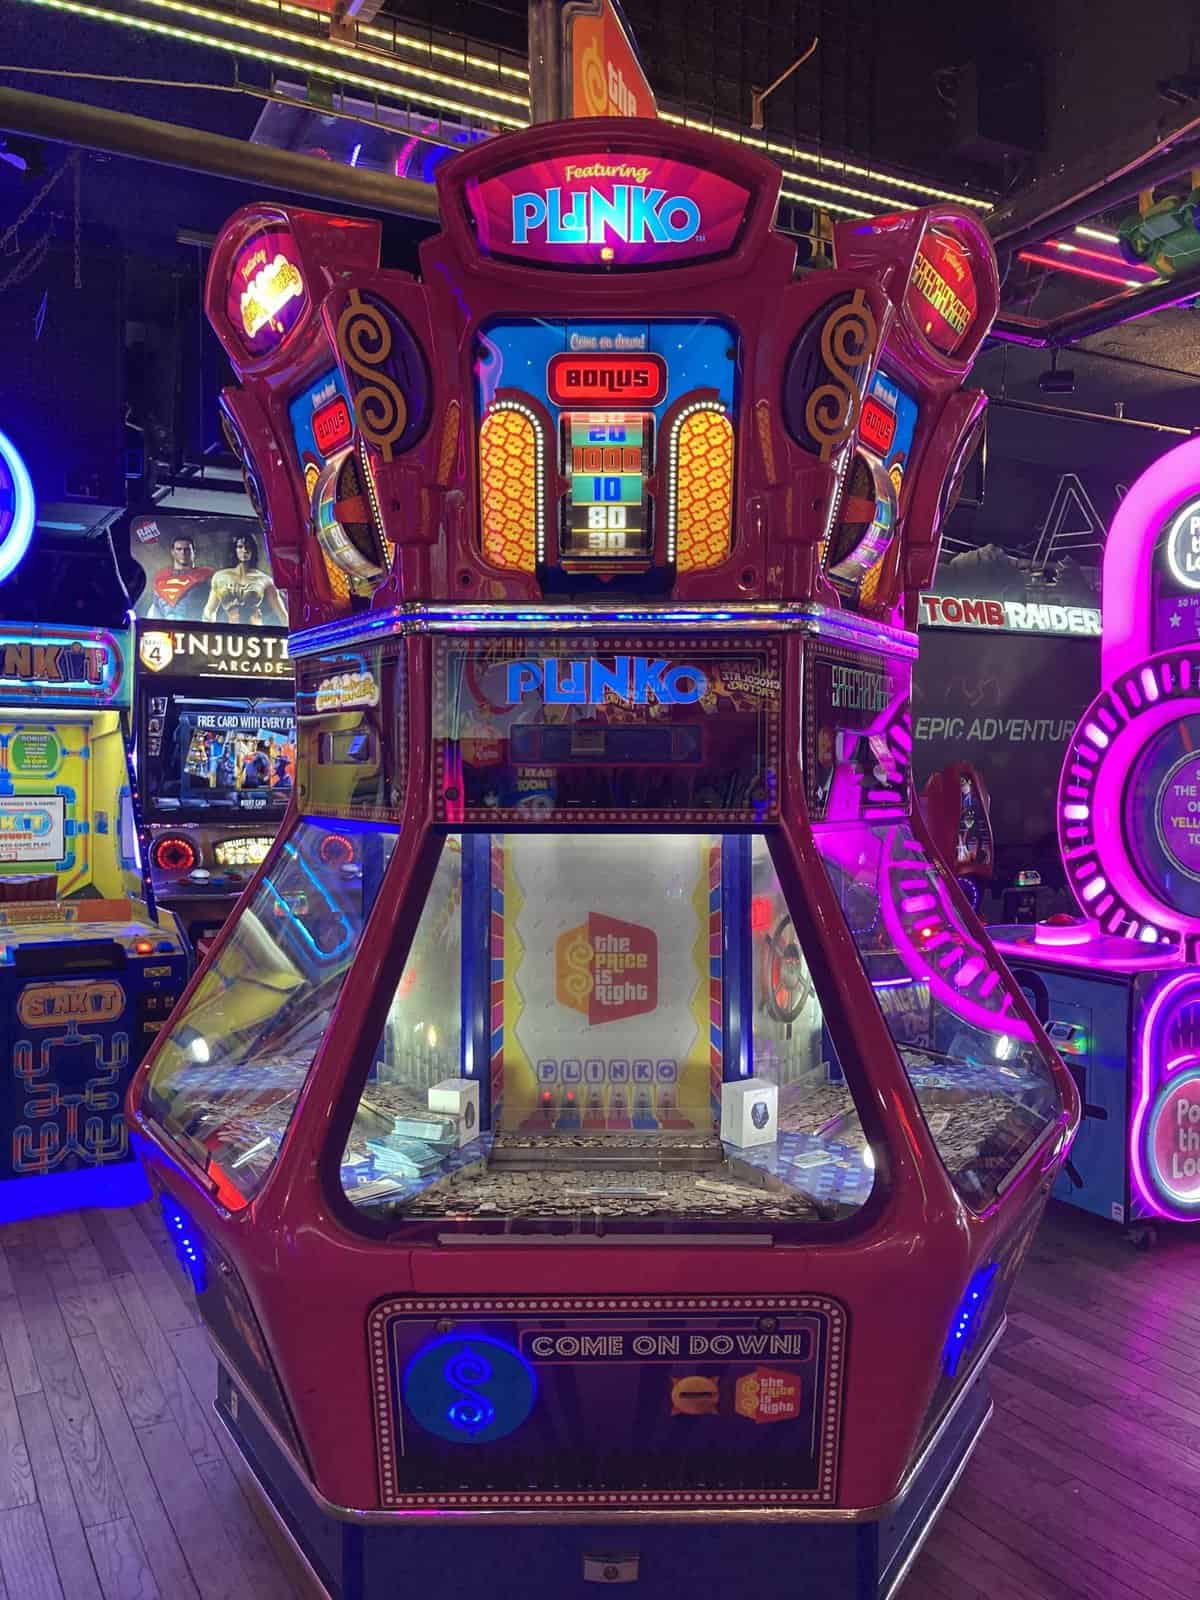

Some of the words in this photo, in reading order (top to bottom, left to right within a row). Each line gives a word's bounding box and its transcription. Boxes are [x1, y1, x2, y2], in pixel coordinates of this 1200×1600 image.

[565, 163, 650, 182] Featuring
[512, 184, 701, 244] PLINKO
[593, 476, 622, 502] 10
[588, 506, 627, 530] 80
[922, 596, 1005, 626] TOMB
[1004, 601, 1103, 635] RAIDER
[217, 660, 284, 674] ARCADE
[505, 655, 708, 705] PLINKO
[198, 715, 217, 728] FREE
[218, 715, 239, 728] CARD
[240, 716, 261, 729] WITH
[261, 717, 285, 729] EVERY
[914, 717, 963, 740] EPIC
[1173, 785, 1197, 797] THE
[1170, 816, 1200, 829] YELL
[594, 935, 630, 952] the
[595, 970, 612, 985] is
[539, 1060, 676, 1082] PLINKO
[531, 1336, 623, 1356] COME
[632, 1335, 680, 1356] ON
[689, 1334, 801, 1355] DOWN!
[760, 1376, 784, 1387] the
